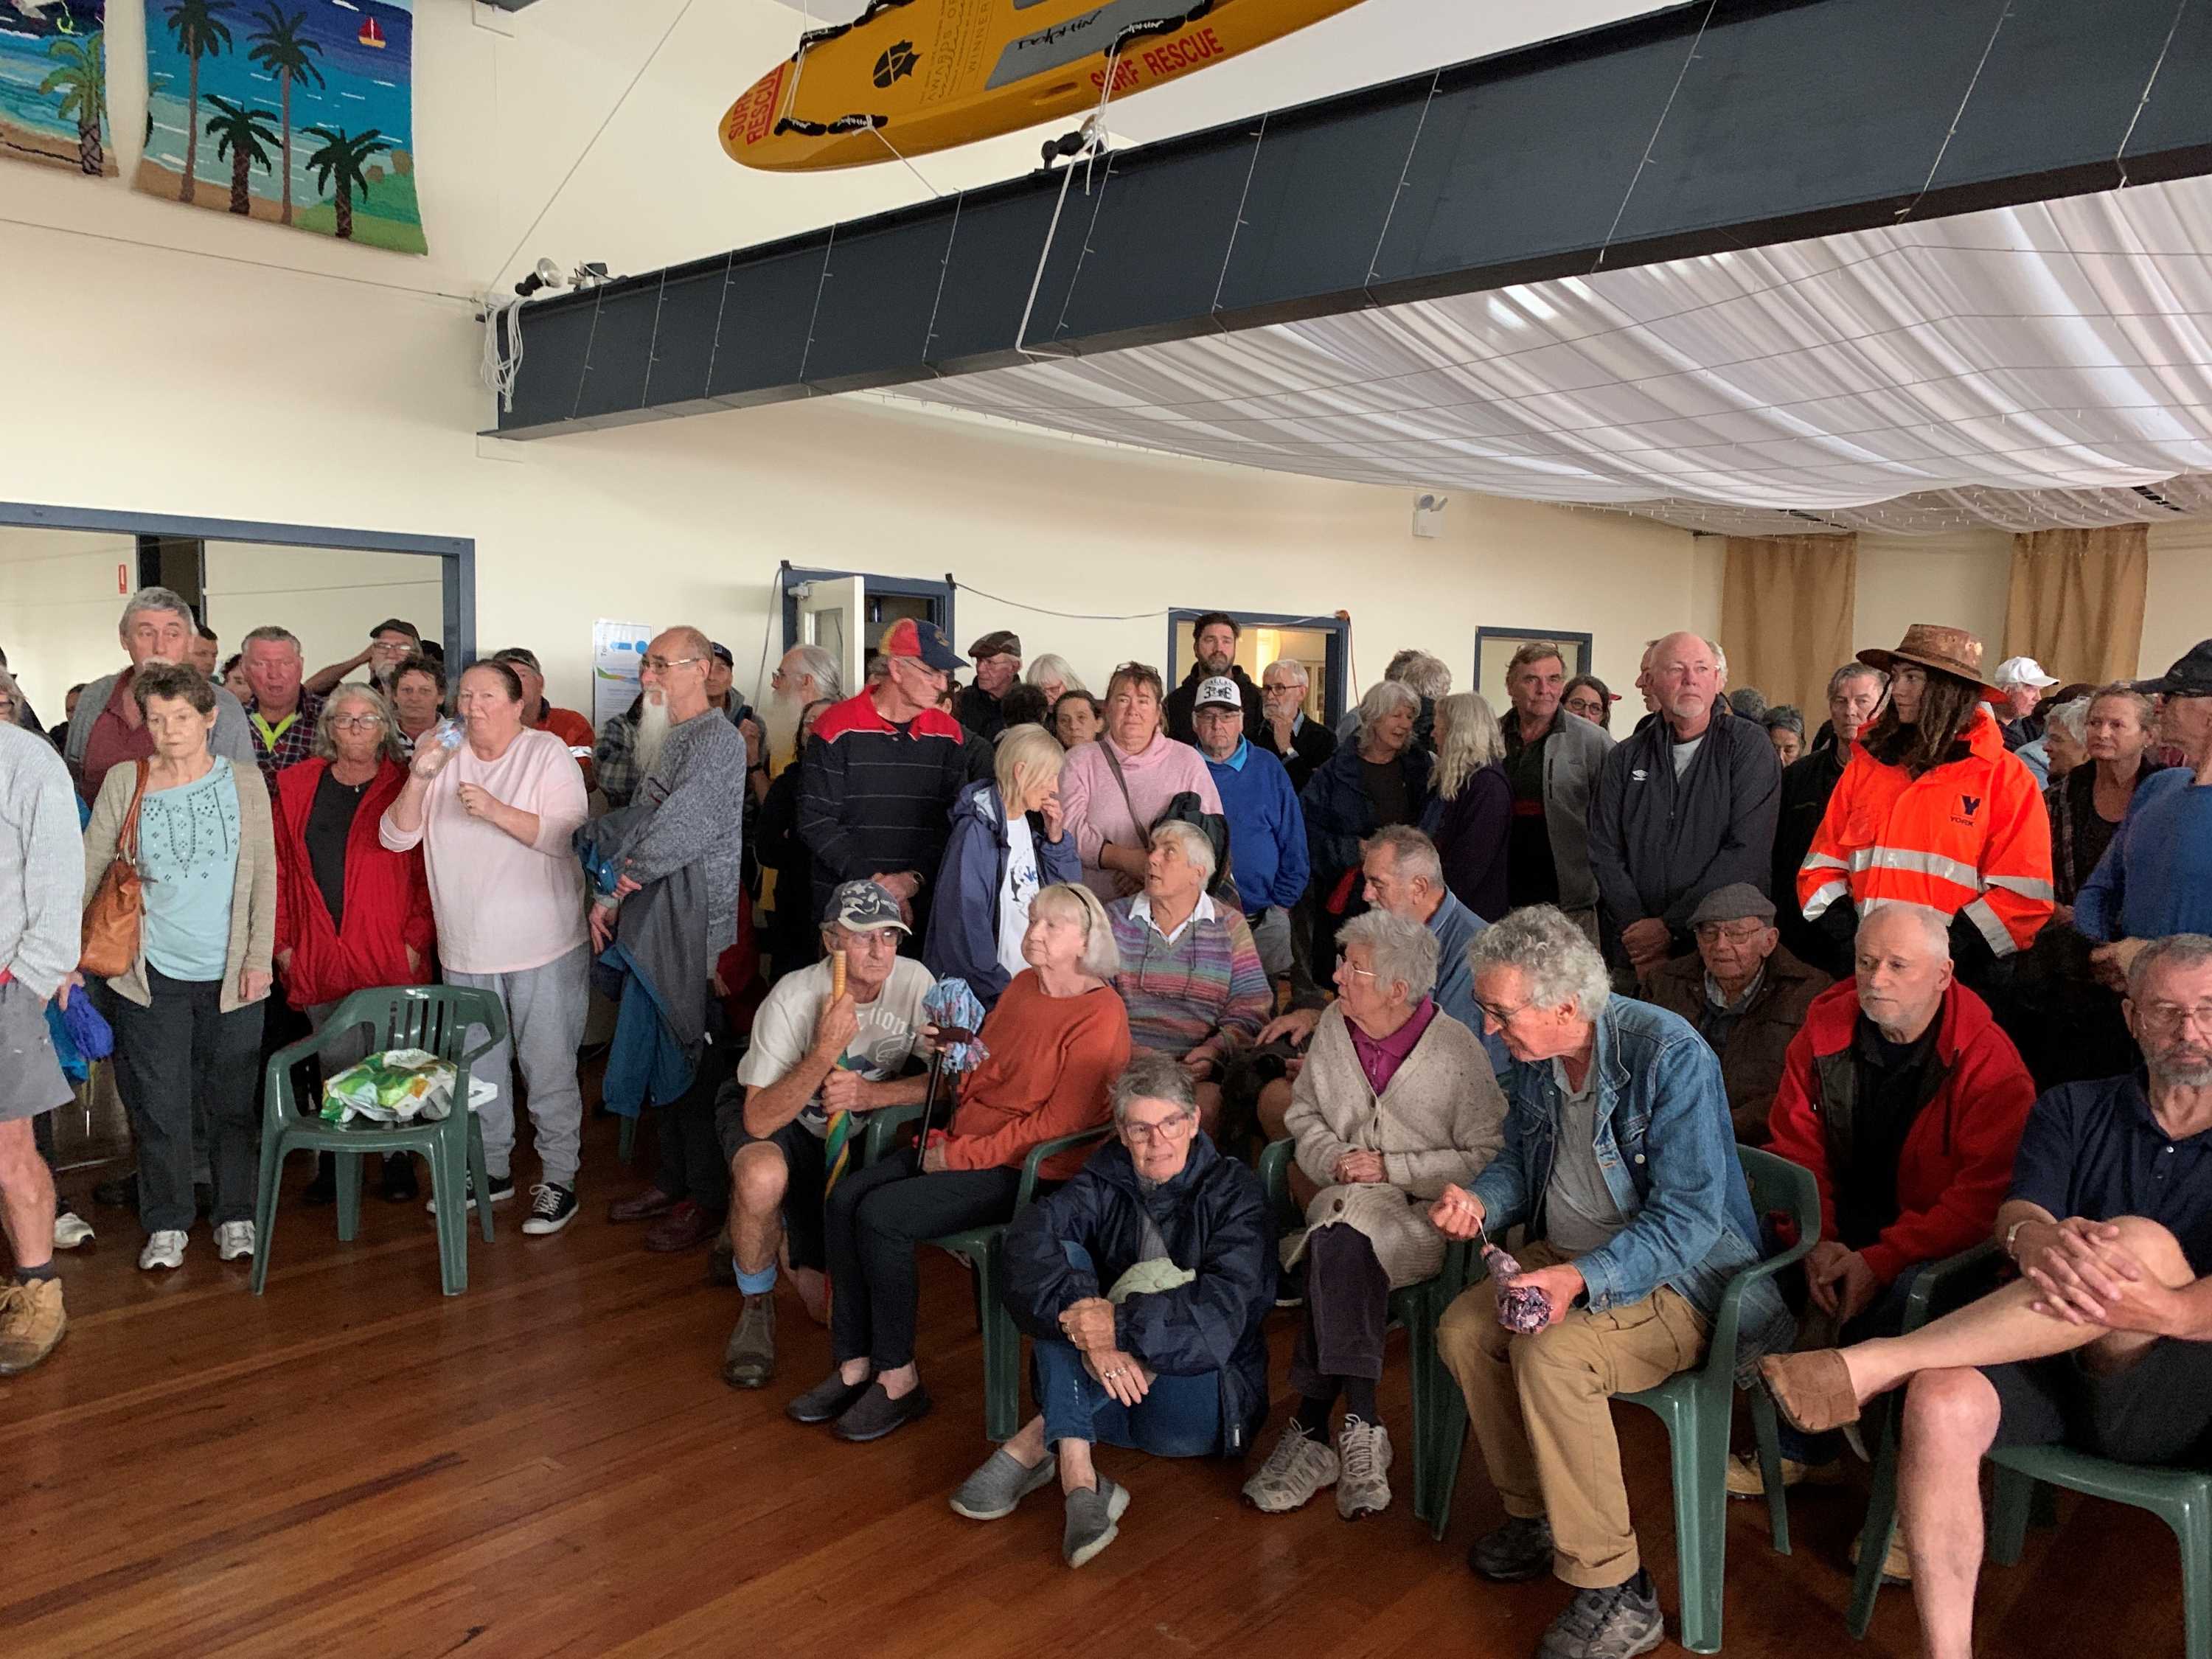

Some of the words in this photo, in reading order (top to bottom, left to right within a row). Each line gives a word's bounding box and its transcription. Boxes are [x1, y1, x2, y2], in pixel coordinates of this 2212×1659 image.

[1091, 59, 1140, 94] SURF
[1143, 27, 1225, 77] RESCUE
[746, 70, 778, 145] RESCU
[1950, 815, 1975, 827] YORK
